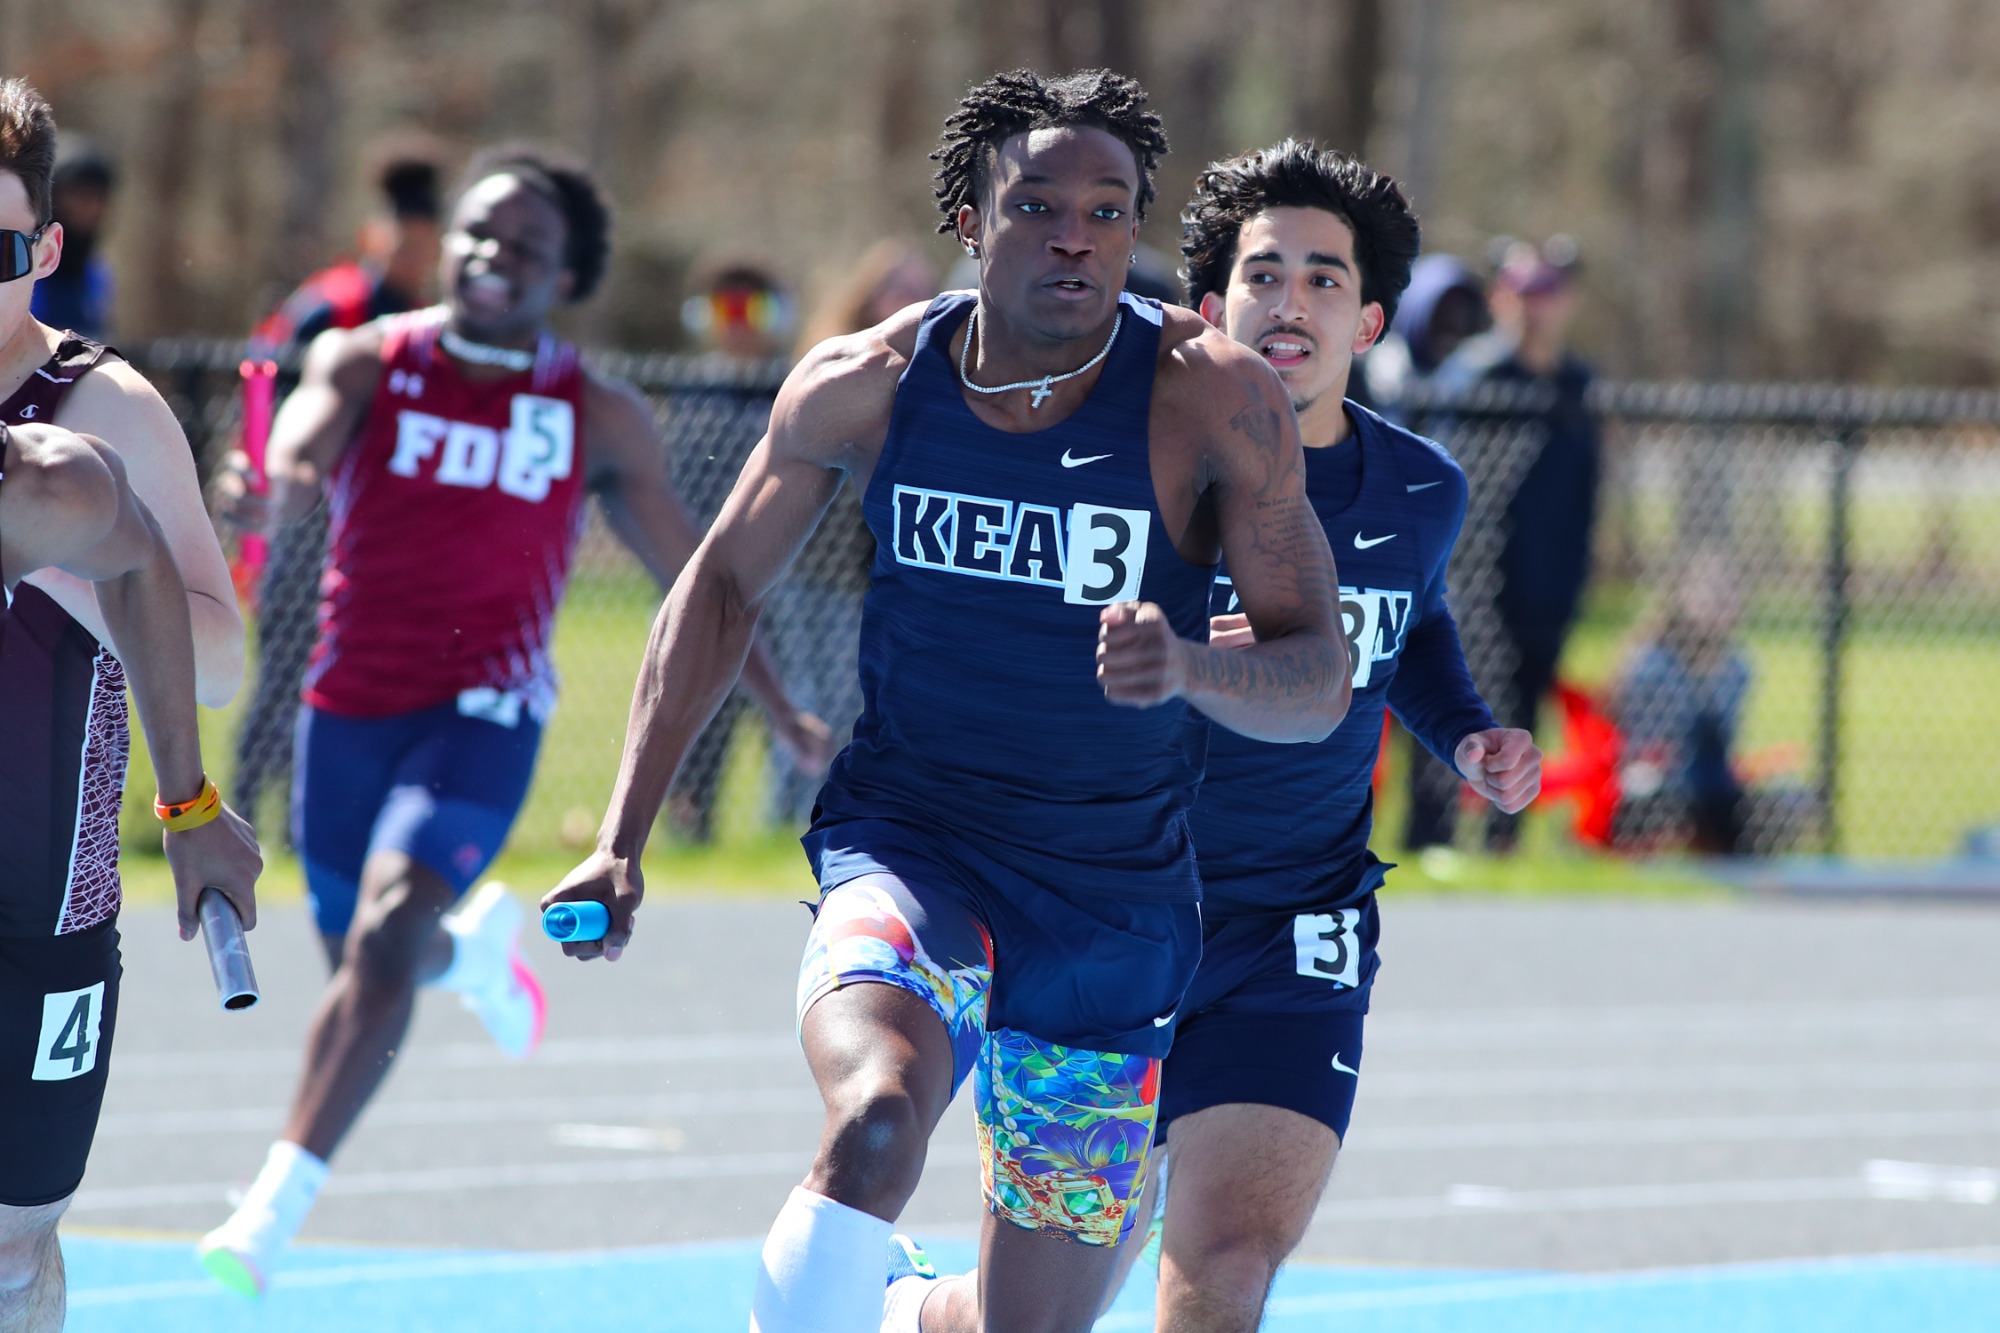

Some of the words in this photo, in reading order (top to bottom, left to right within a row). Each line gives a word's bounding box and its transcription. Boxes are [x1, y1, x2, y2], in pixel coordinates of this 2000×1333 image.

[531, 405, 558, 465] 5
[892, 483, 1074, 588] KEA
[1080, 512, 1131, 601] 3
[1313, 909, 1348, 975] 3
[49, 993, 91, 1073] 4
